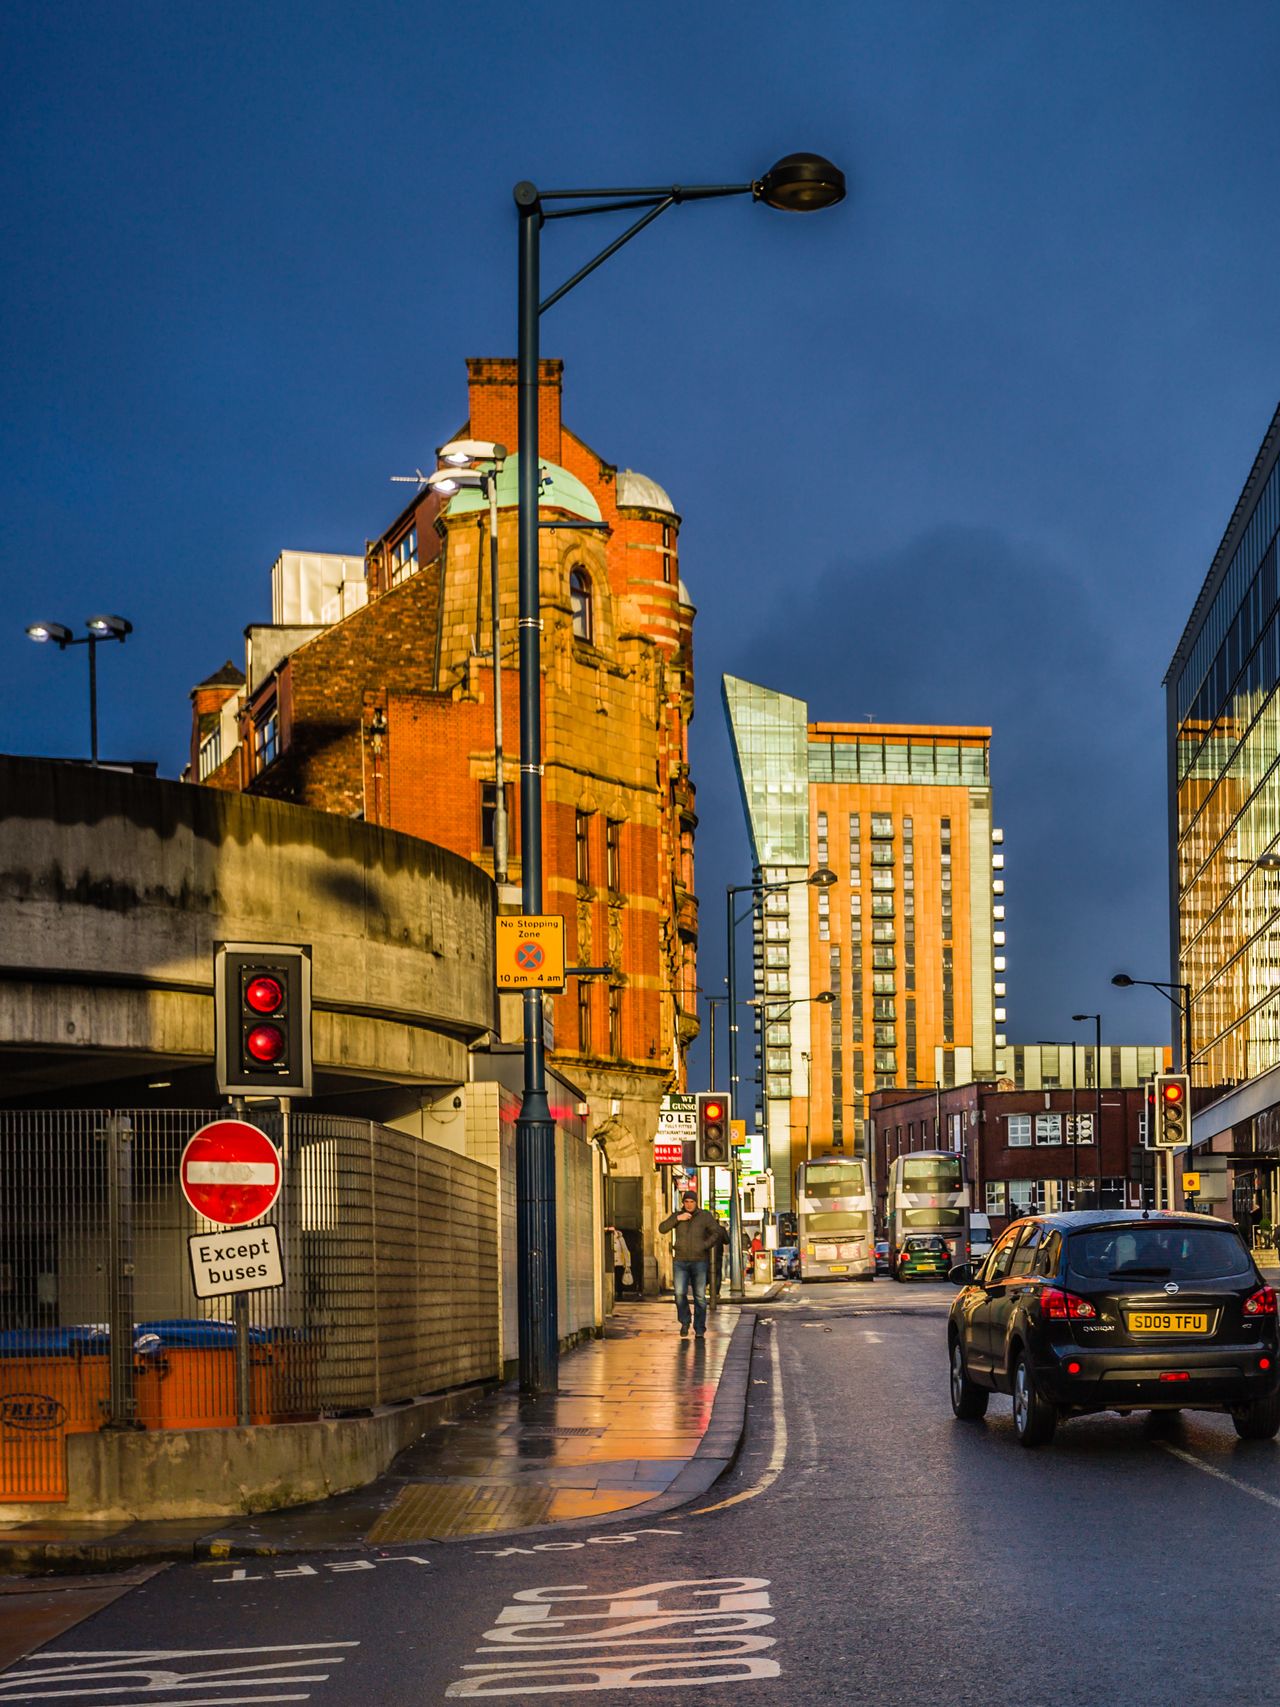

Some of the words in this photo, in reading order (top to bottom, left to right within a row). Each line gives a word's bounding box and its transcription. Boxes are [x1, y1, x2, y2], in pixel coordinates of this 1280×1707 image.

[500, 920, 514, 928] No
[517, 919, 559, 928] Stopping
[518, 930, 541, 938] Zone
[500, 974, 511, 982] 10
[513, 975, 528, 983] pm
[537, 974, 544, 982] 4
[660, 1114, 674, 1123] TO
[678, 1114, 697, 1123] LET
[199, 1238, 270, 1263] Except
[208, 1264, 268, 1284] buses
[1134, 1316, 1171, 1329] SD09
[1175, 1316, 1202, 1329] TFU
[474, 1529, 684, 1557] LOOK
[212, 1556, 431, 1584] LEFT
[445, 1577, 781, 1697] BUSES
